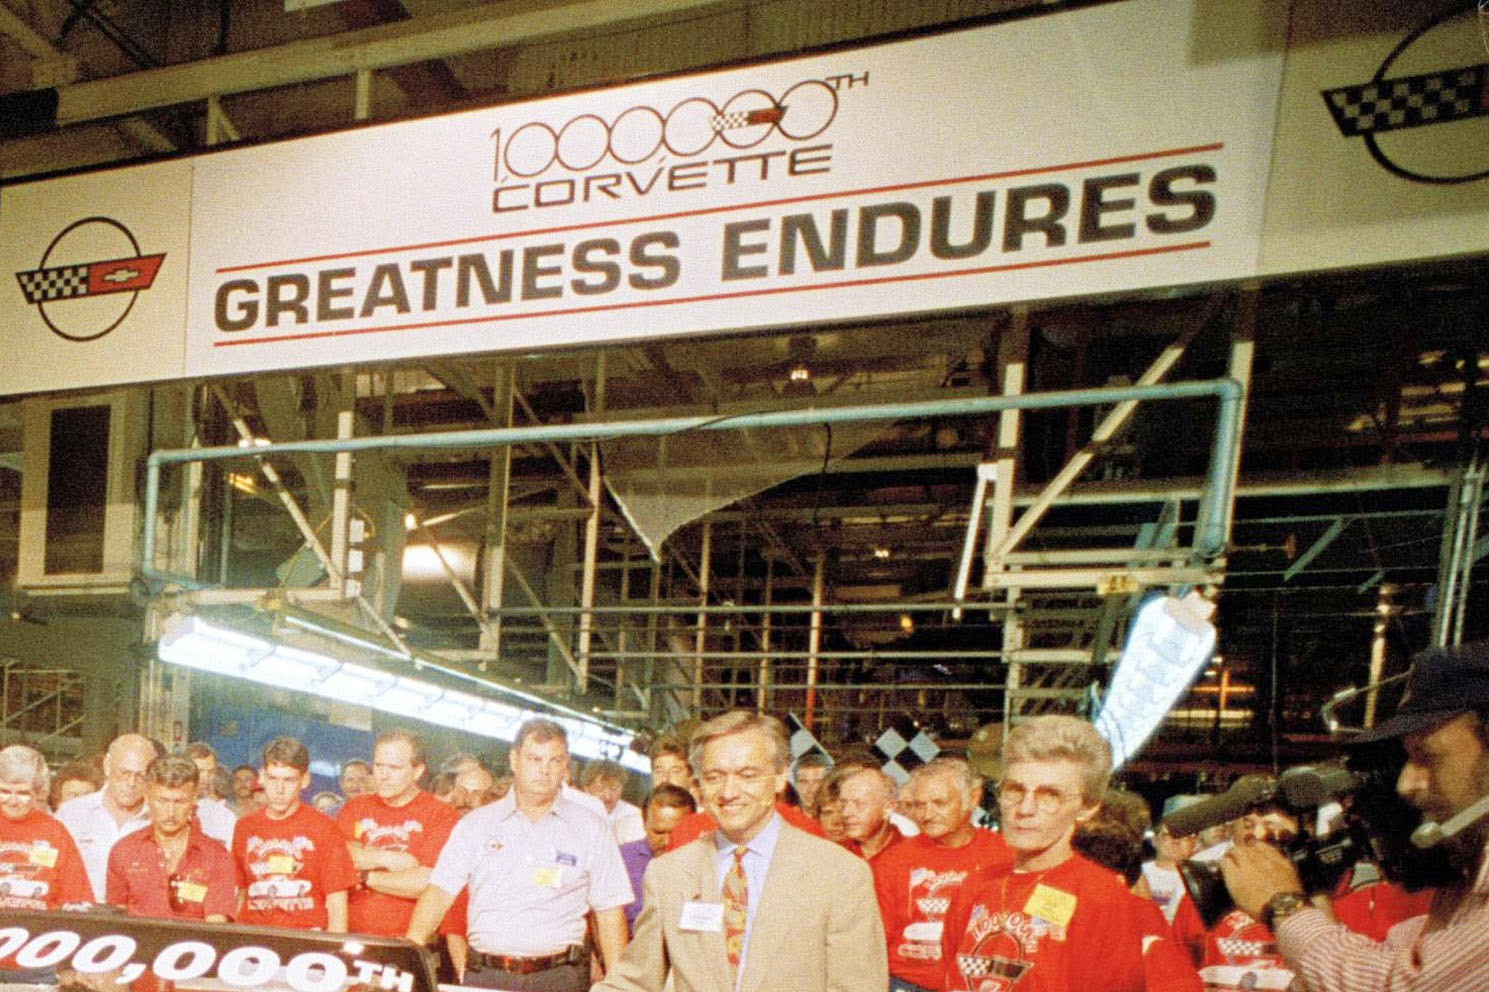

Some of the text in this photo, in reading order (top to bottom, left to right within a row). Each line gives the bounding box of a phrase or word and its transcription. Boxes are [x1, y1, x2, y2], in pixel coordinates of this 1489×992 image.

[492, 143, 833, 213] CORVETTE
[214, 163, 1218, 333] GREATNESS ENDURES
